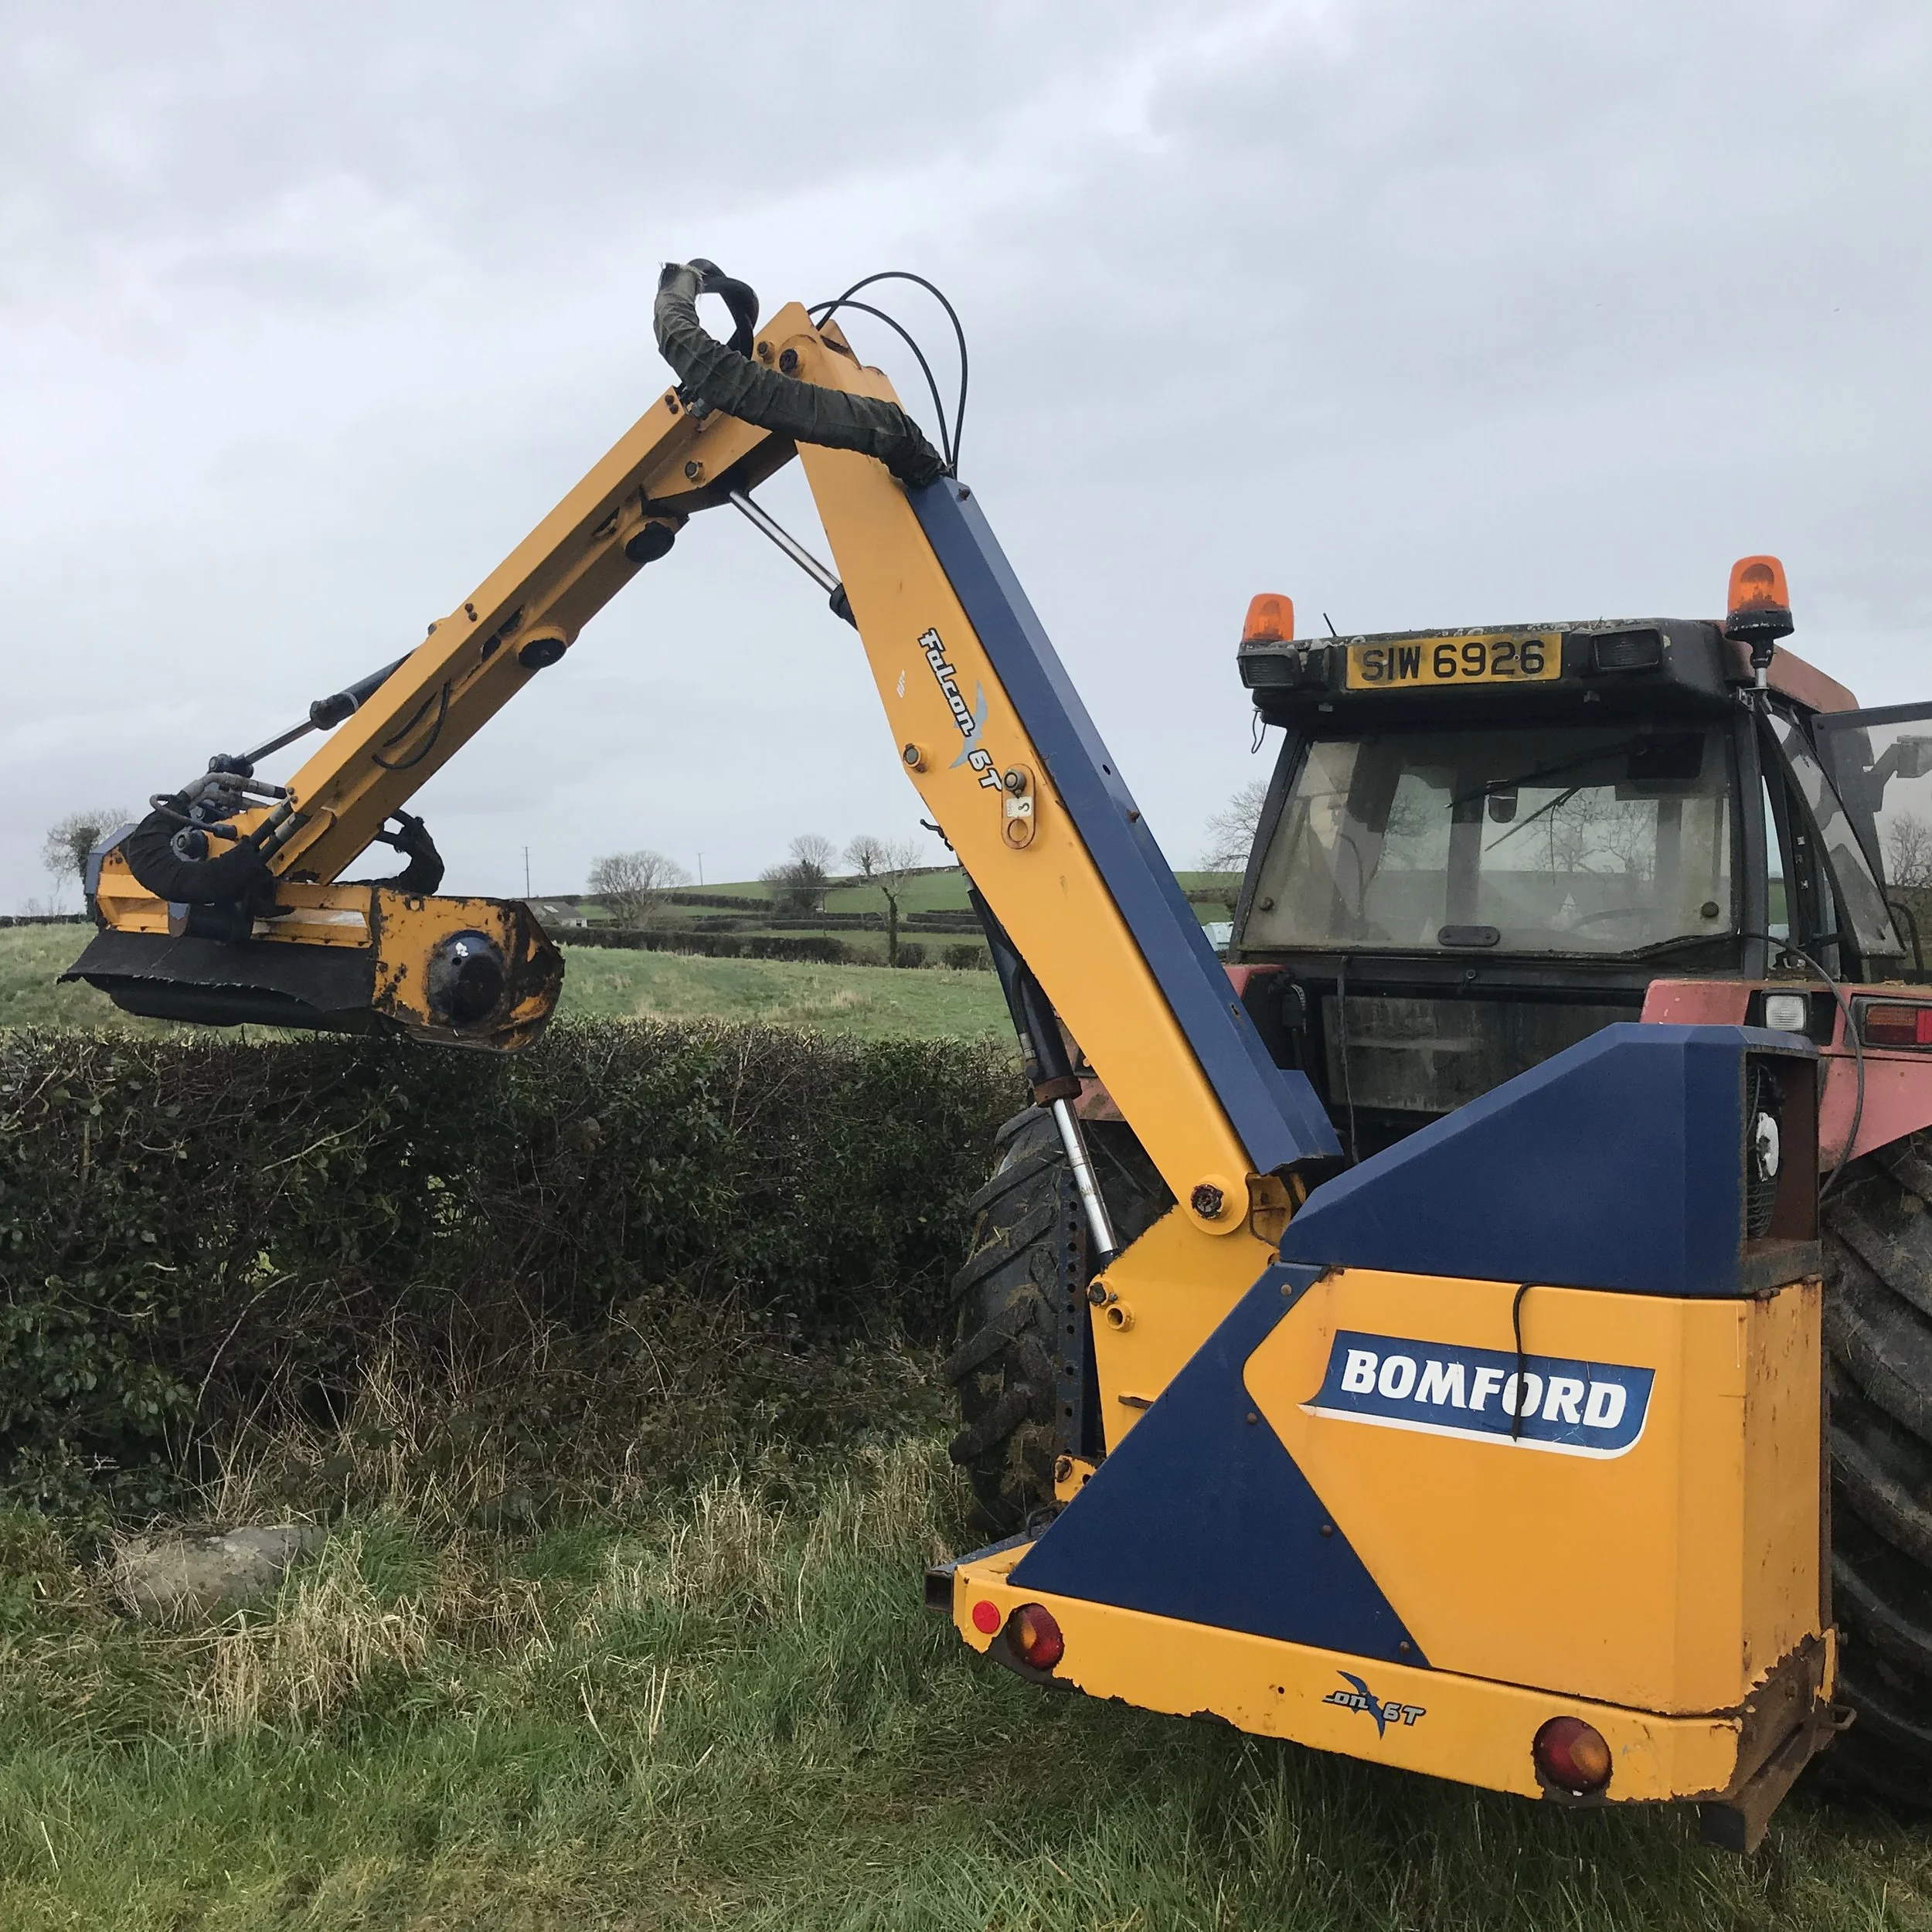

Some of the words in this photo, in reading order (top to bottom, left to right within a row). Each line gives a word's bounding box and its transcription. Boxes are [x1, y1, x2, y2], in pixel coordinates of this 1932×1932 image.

[1362, 646, 1421, 681] SIW
[1434, 640, 1545, 678] 6926
[968, 749, 1002, 791] 6T
[1341, 1349, 1627, 1429] BOMFORD
[1322, 1691, 1369, 1710] on
[1382, 1702, 1426, 1726] 6T
